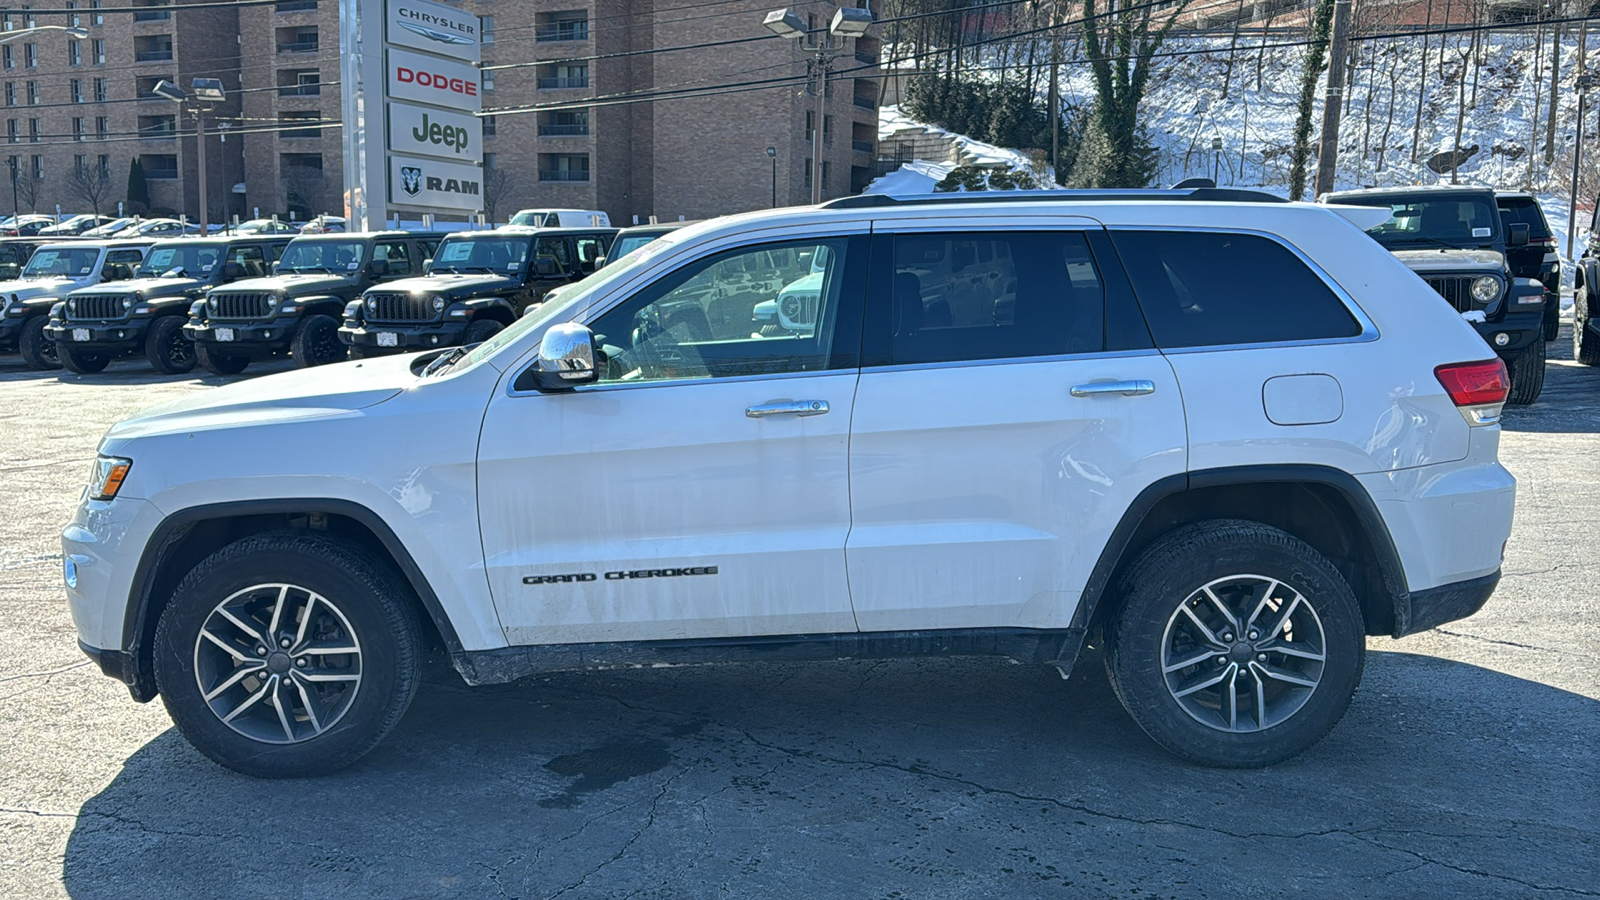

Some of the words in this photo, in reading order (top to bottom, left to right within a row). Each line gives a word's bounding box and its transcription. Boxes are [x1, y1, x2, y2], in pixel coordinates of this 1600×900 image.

[398, 8, 474, 34] CHRYSLER
[397, 67, 477, 96] DODGE
[412, 113, 468, 153] Jeep
[426, 176, 479, 195] RAM
[522, 573, 597, 585] GRAND
[604, 565, 719, 580] CHEROKEE
